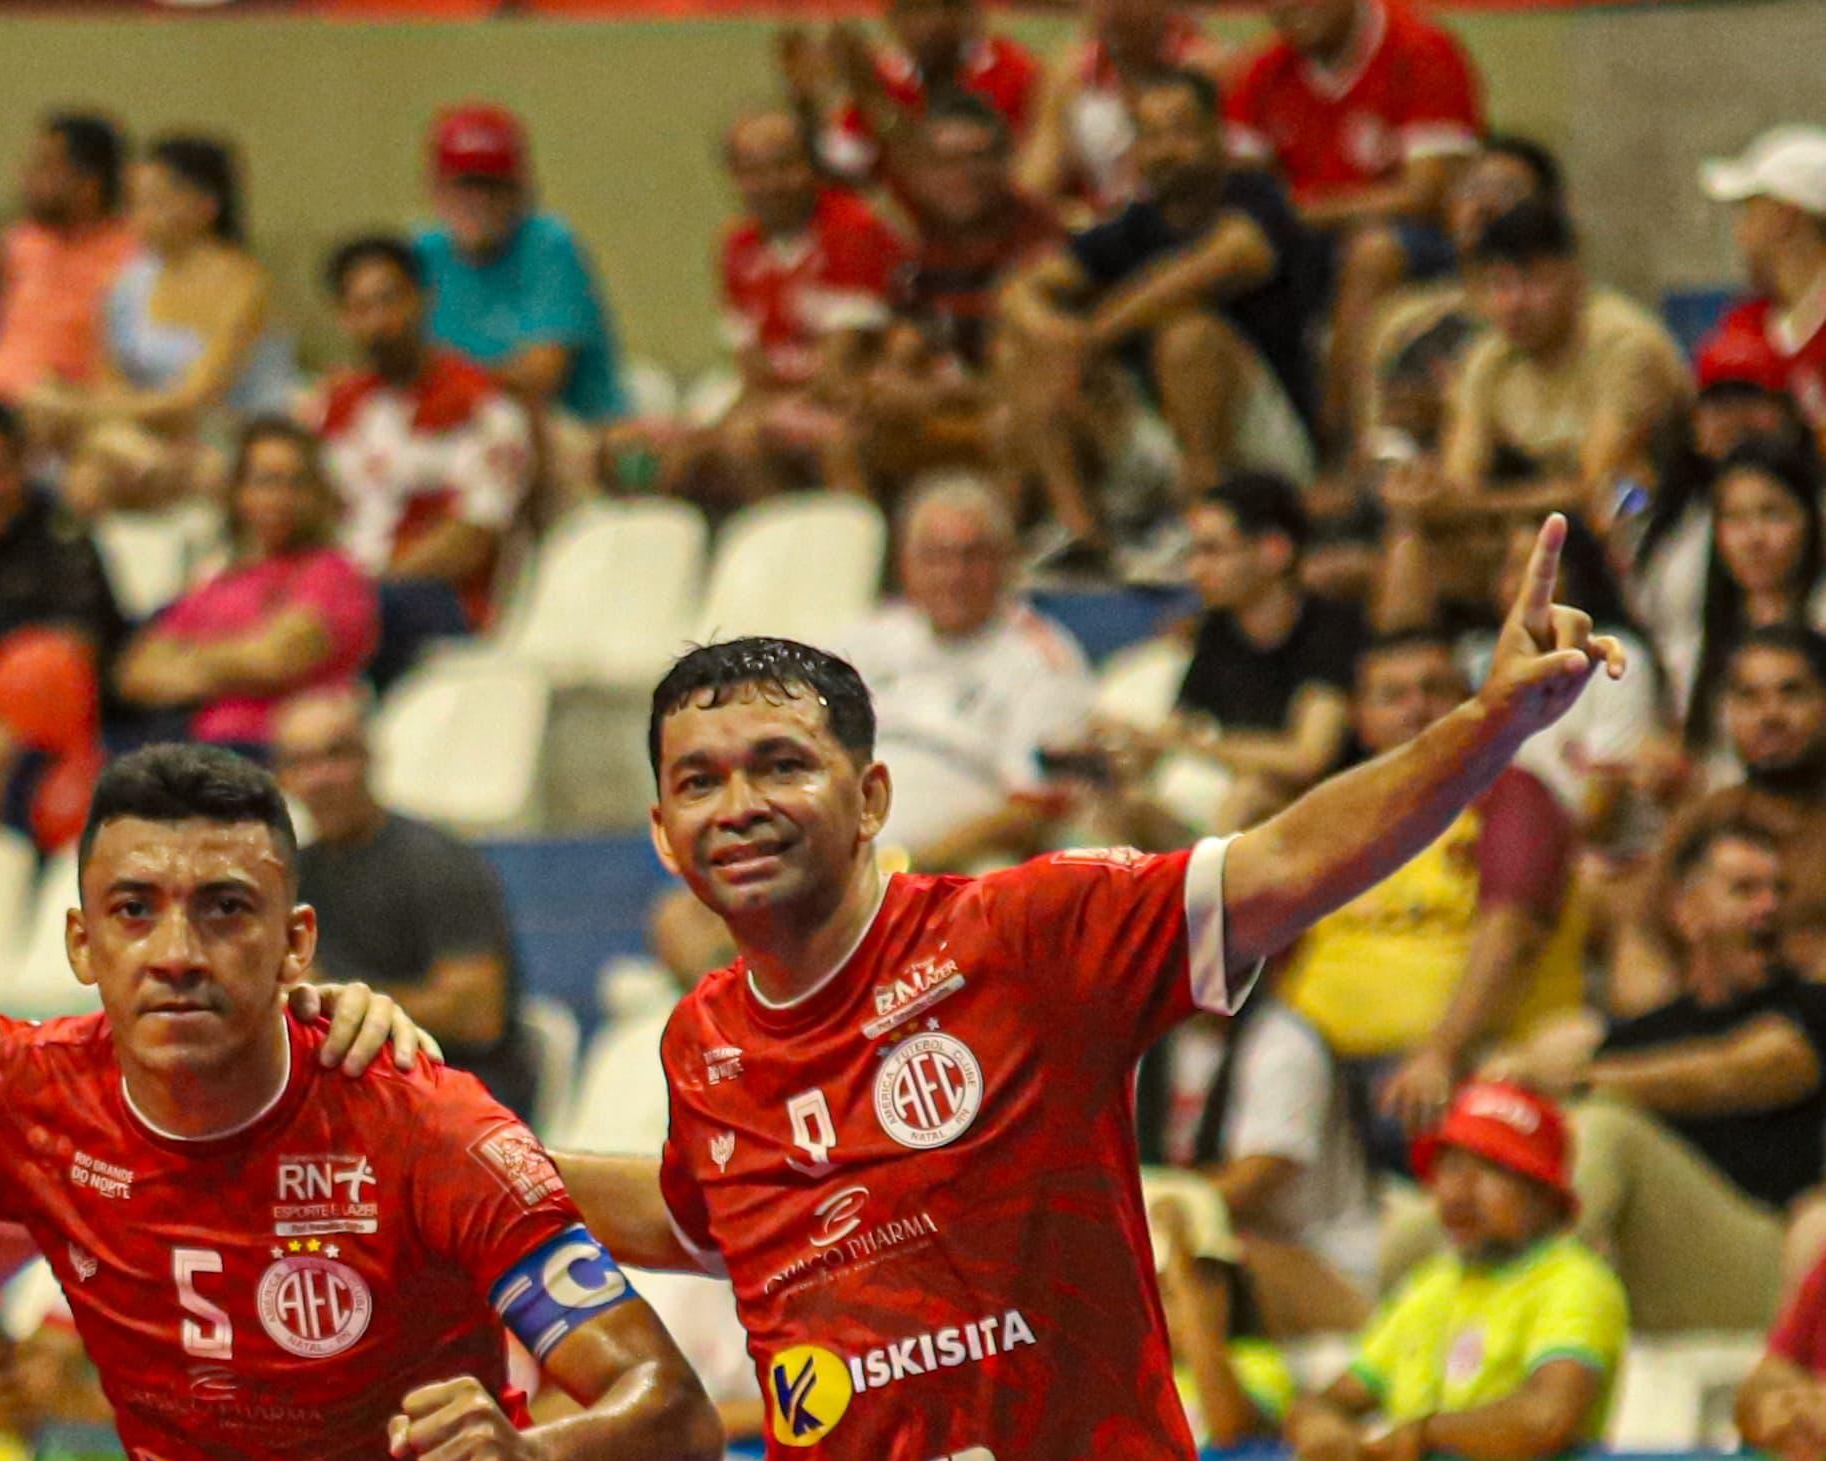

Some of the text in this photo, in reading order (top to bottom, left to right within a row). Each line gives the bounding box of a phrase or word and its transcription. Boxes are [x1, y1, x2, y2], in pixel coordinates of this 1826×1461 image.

[173, 1248, 233, 1360] 5
[542, 1242, 626, 1309] C
[850, 1308, 1037, 1393] ISKISITA
